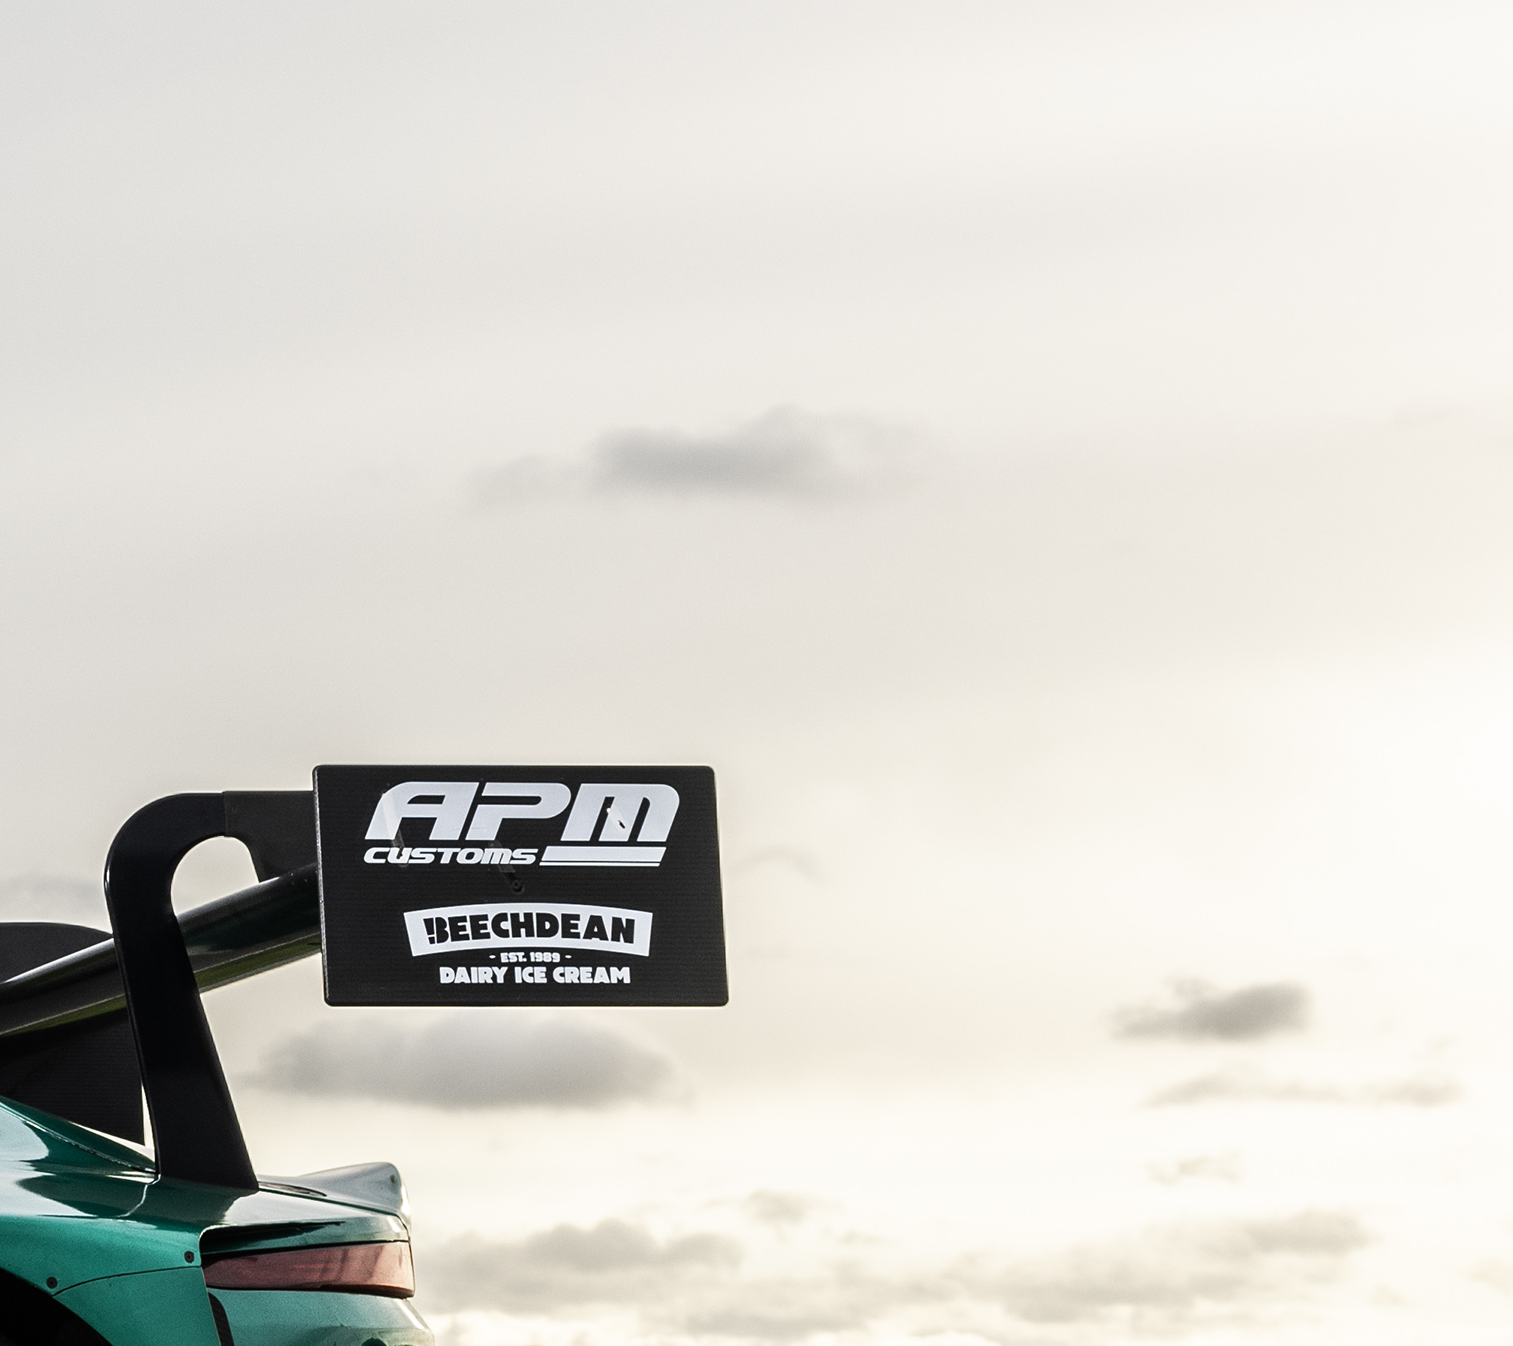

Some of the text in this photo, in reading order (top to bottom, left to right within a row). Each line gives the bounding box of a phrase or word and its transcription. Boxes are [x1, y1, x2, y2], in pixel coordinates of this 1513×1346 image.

[364, 781, 680, 842] APM
[364, 846, 539, 865] CUSTOMS
[501, 952, 560, 963] EST. 1989
[439, 966, 631, 984] DAIRY ICE CREAM
